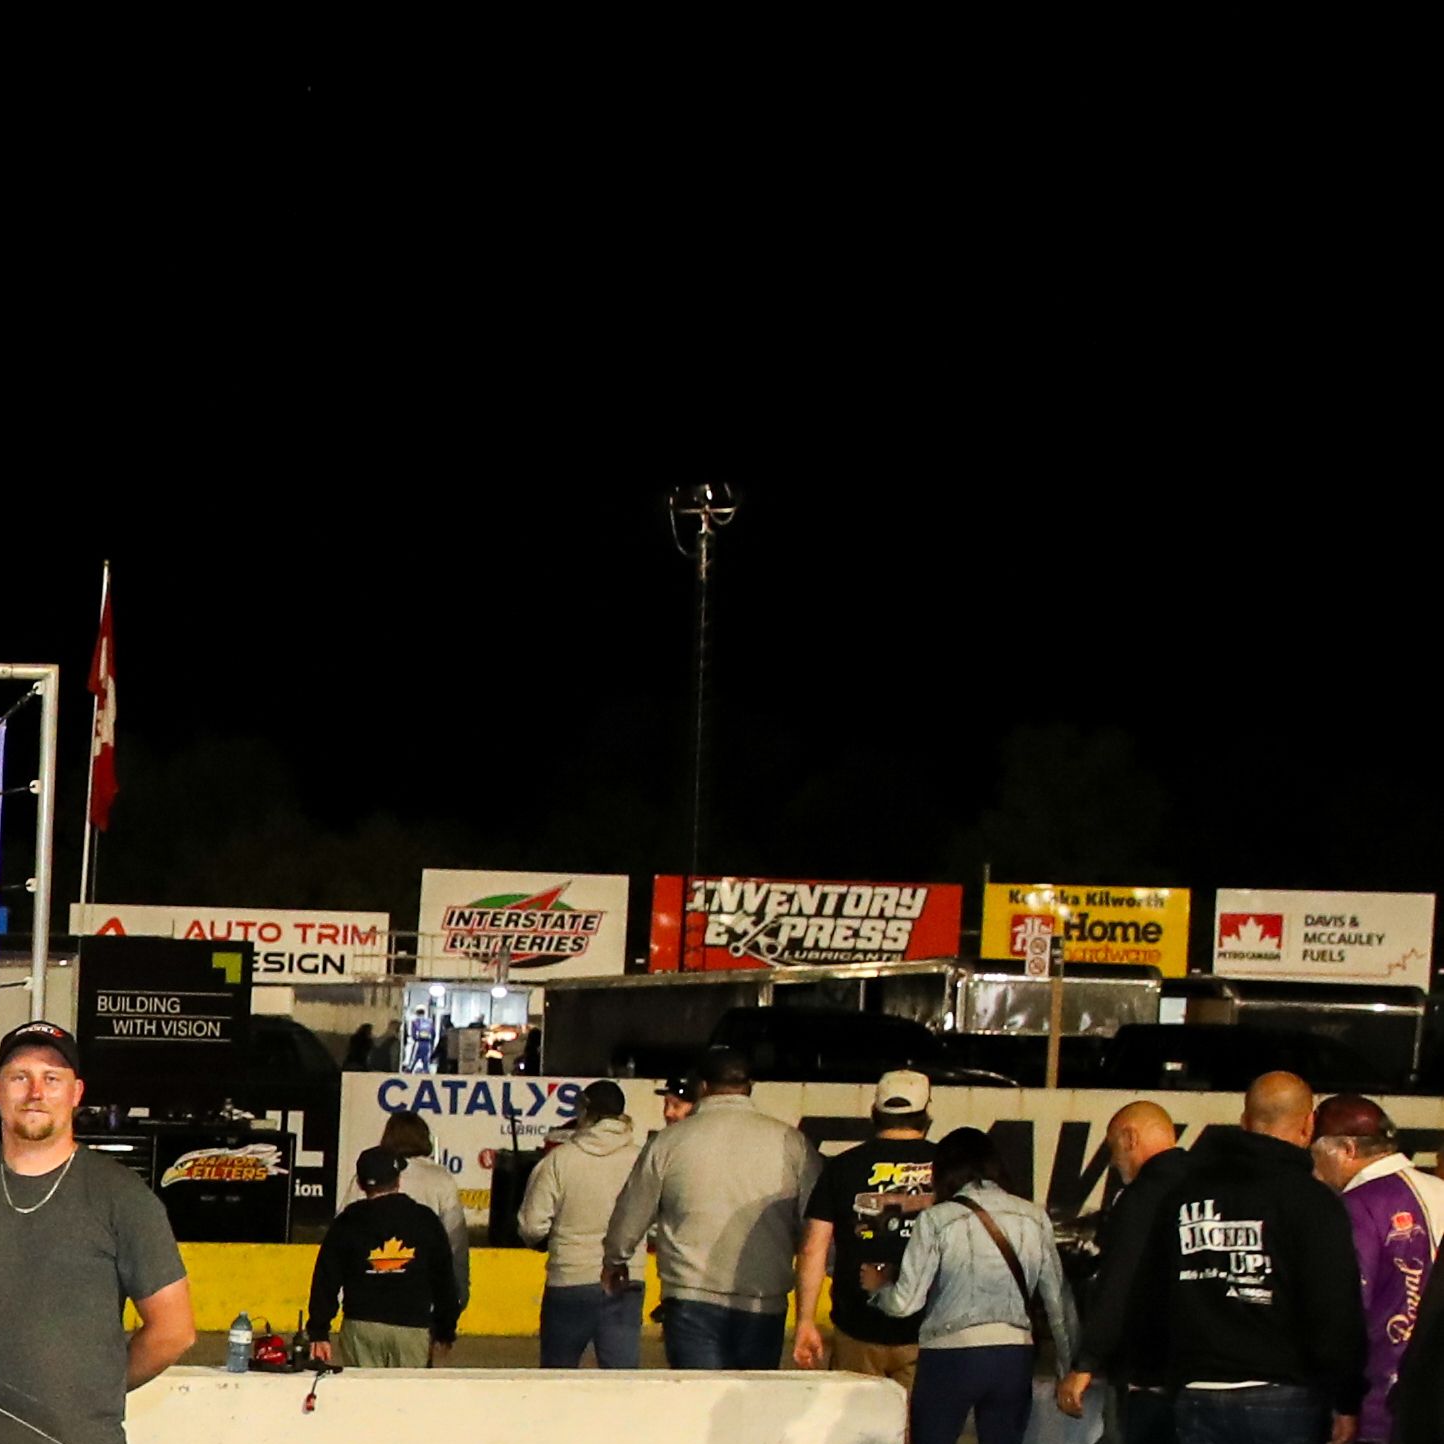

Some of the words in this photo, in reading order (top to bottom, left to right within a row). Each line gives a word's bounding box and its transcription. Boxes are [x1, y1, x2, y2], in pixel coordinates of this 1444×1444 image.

[686, 880, 928, 919] INVENTORY
[446, 910, 599, 931] INTERSTATE
[1063, 912, 1163, 944] Home
[1304, 915, 1345, 927] DAVIS
[1349, 915, 1360, 927] &
[184, 920, 282, 943] AUTO
[294, 923, 378, 945] TRIM
[448, 934, 586, 952] BATTERIES
[1303, 932, 1385, 946] MCCAULEY
[253, 951, 345, 974] ESIGN
[1302, 949, 1345, 963] FUELS
[97, 997, 181, 1014] BUILDING
[112, 1019, 155, 1036] WITH
[161, 1020, 221, 1037] VISION
[378, 1078, 586, 1118] CATALYS
[193, 1166, 268, 1181] FILTERS
[1179, 1200, 1221, 1224] ALL
[1229, 1252, 1272, 1274] UP!
